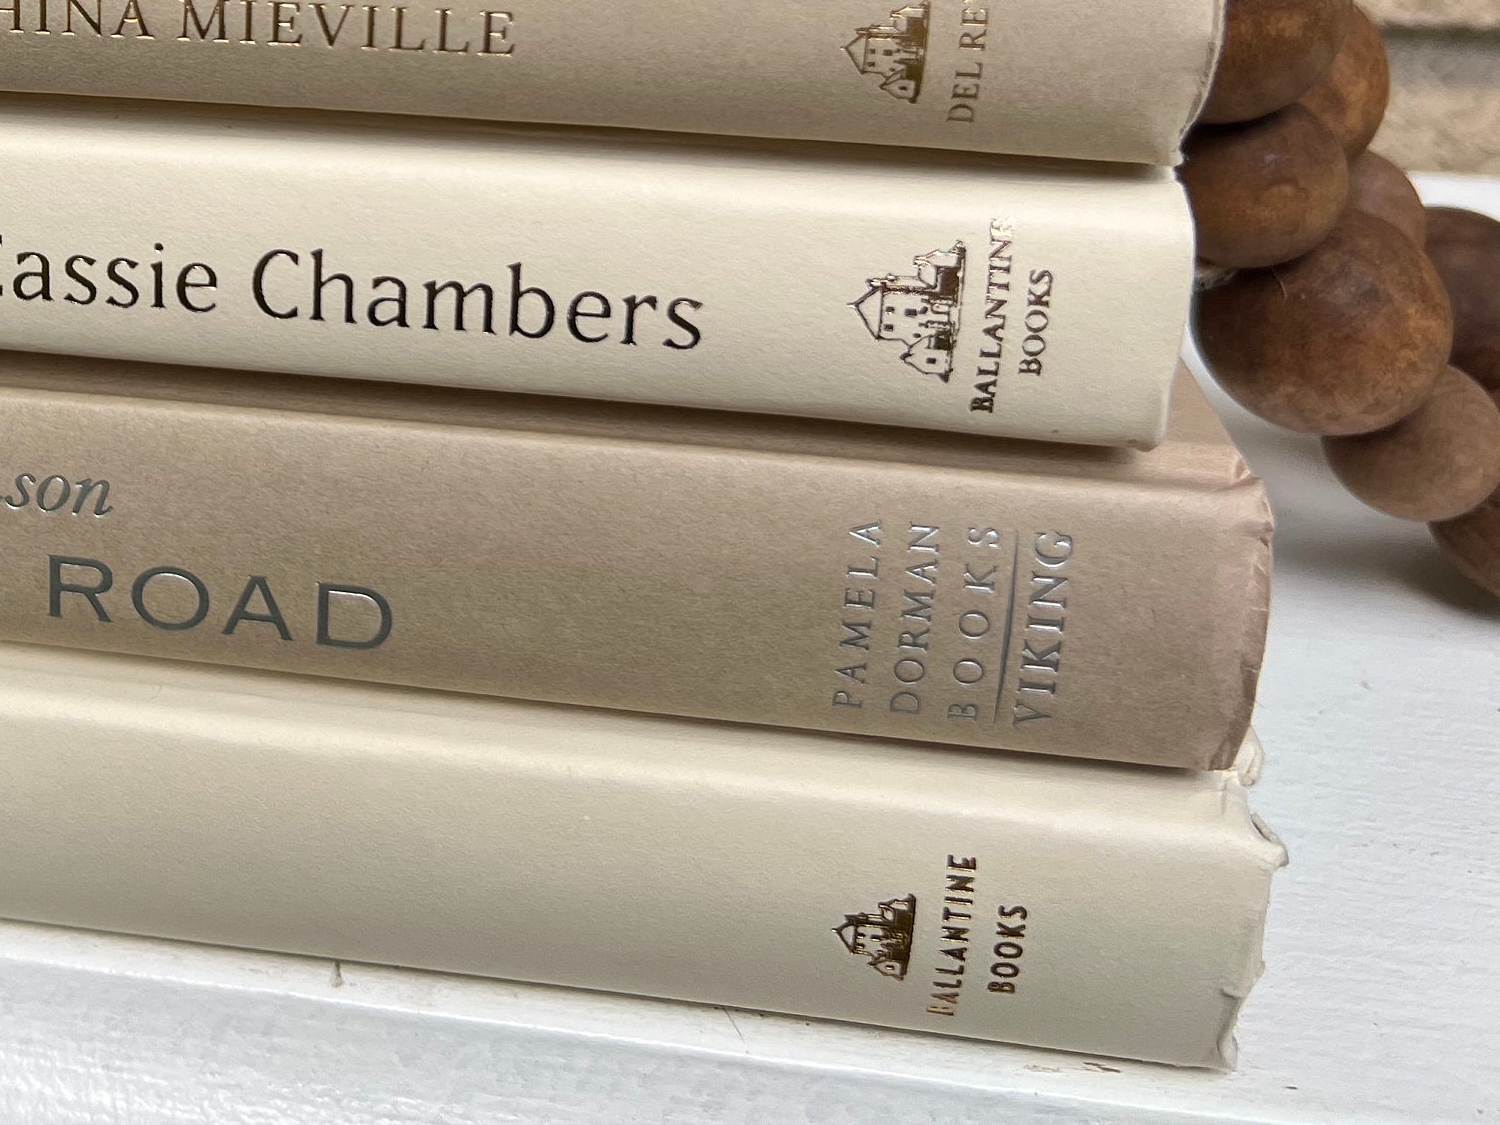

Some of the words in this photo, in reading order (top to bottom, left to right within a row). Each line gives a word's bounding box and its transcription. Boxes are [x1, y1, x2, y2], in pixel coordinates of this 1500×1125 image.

[947, 61, 984, 124] DEL
[252, 247, 705, 353] Chambers
[1018, 268, 1054, 376] BOOKS
[47, 554, 393, 650] ROAD
[832, 519, 884, 710] PAMELA
[889, 521, 940, 713] DORMAN
[947, 525, 1000, 721] BOOKS
[1012, 530, 1075, 727] VIKING
[926, 854, 978, 1016] BALLANTINE
[988, 905, 1028, 994] BOOKS
